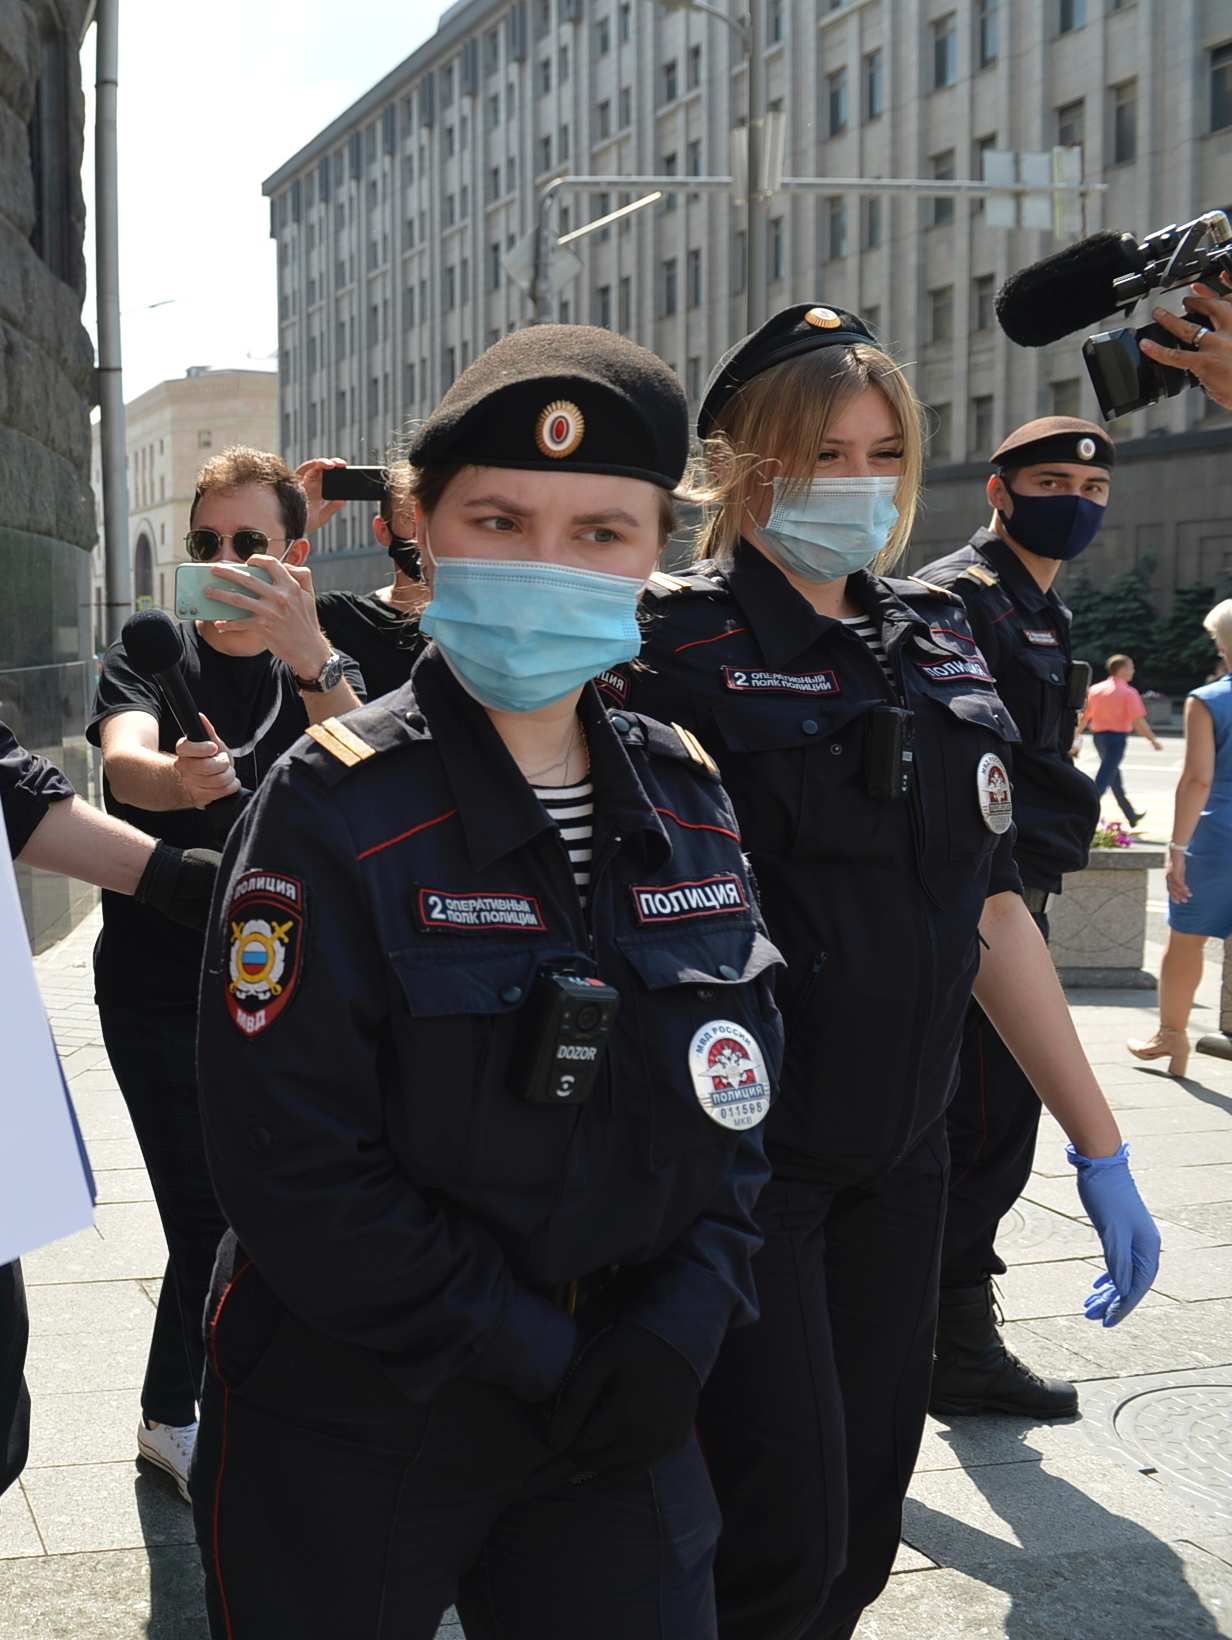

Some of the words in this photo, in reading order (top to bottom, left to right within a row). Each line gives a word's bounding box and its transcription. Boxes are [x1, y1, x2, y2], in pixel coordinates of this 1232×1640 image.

[734, 671, 749, 686] 2
[751, 679, 781, 687] ПОЛК
[428, 895, 447, 920] 2
[445, 897, 531, 913] ОПЕРАТИВНЫЙ
[639, 883, 741, 915] ПОЛИЦИЯ
[446, 910, 479, 925] ПОЛК
[480, 911, 538, 926] ПОЛИЦИИ
[236, 1008, 267, 1033] МВД
[556, 1044, 598, 1061] DOZOR
[712, 1085, 763, 1105] ПОЛИЦИЯ
